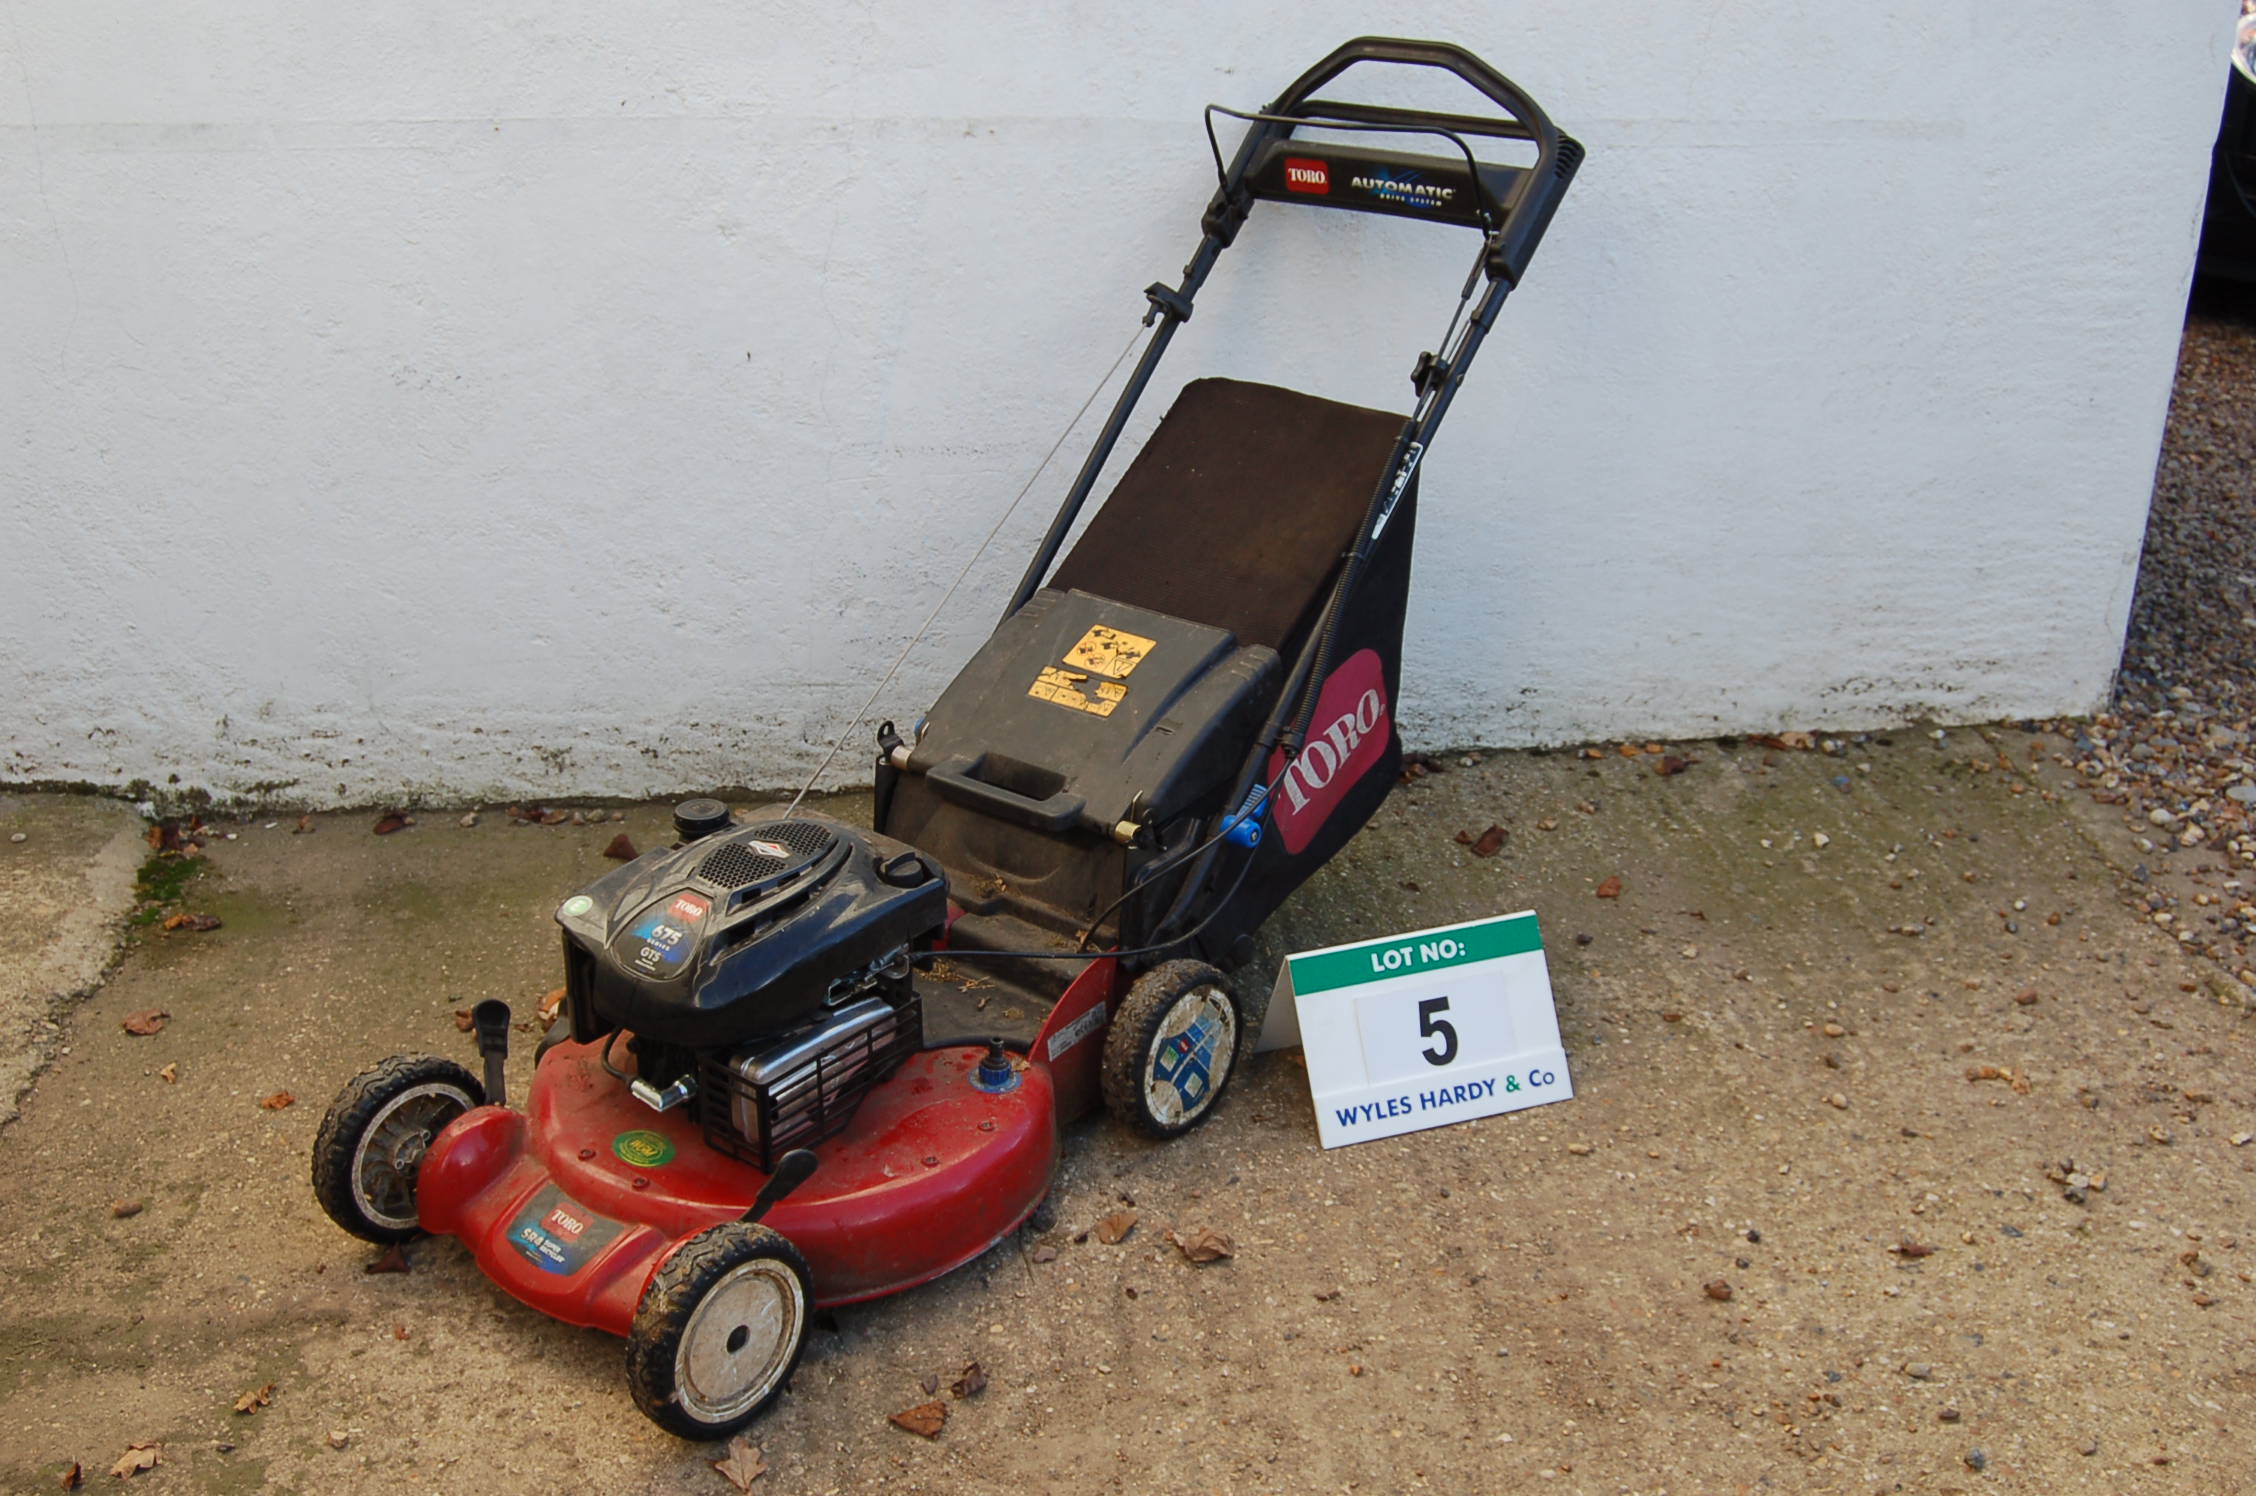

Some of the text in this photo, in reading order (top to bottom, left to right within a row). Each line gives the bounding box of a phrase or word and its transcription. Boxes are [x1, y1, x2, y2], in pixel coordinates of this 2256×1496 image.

[1287, 167, 1326, 185] TORO
[1351, 176, 1454, 199] AUTOMATIC
[1283, 689, 1381, 816] TORO
[675, 899, 703, 916] TORO
[652, 925, 682, 945] 675
[640, 946, 662, 962] GTS
[1371, 938, 1467, 973] LOT NO:
[1418, 996, 1459, 1066] 5
[1336, 1096, 1412, 1127] WYLES
[1419, 1078, 1496, 1110] HARDY
[1505, 1074, 1521, 1093] &
[551, 1208, 584, 1235] TORO
